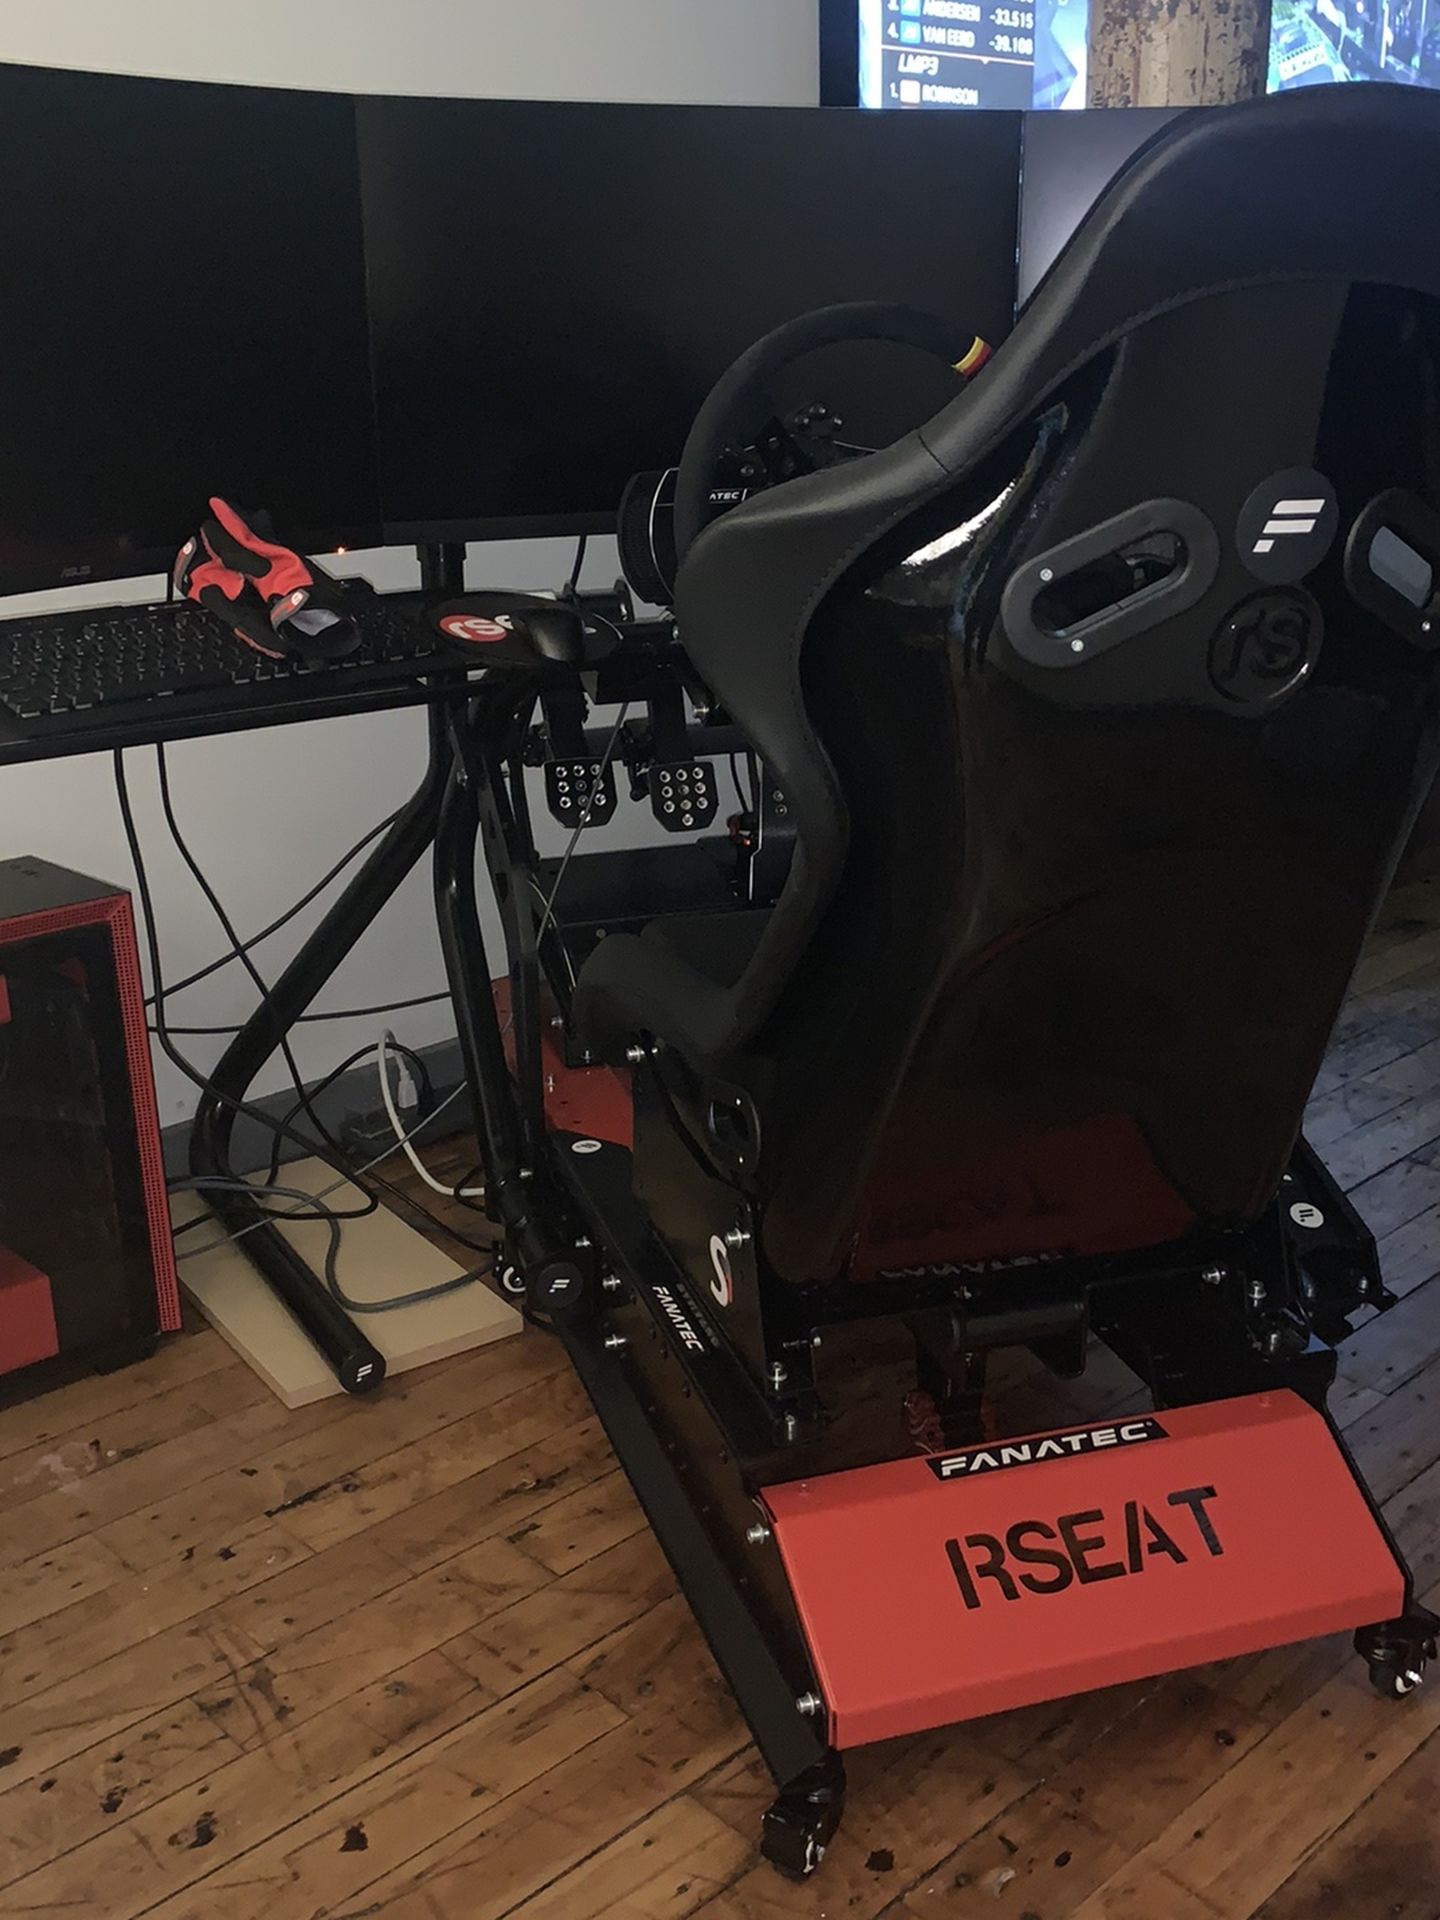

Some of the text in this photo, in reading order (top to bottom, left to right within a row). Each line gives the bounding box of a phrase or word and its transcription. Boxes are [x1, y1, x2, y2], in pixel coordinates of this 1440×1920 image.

[709, 491, 740, 501] ATEC
[652, 1286, 705, 1352] FANATEC
[940, 1422, 1150, 1477] FANATEC
[945, 1484, 1224, 1610] RSEAT
